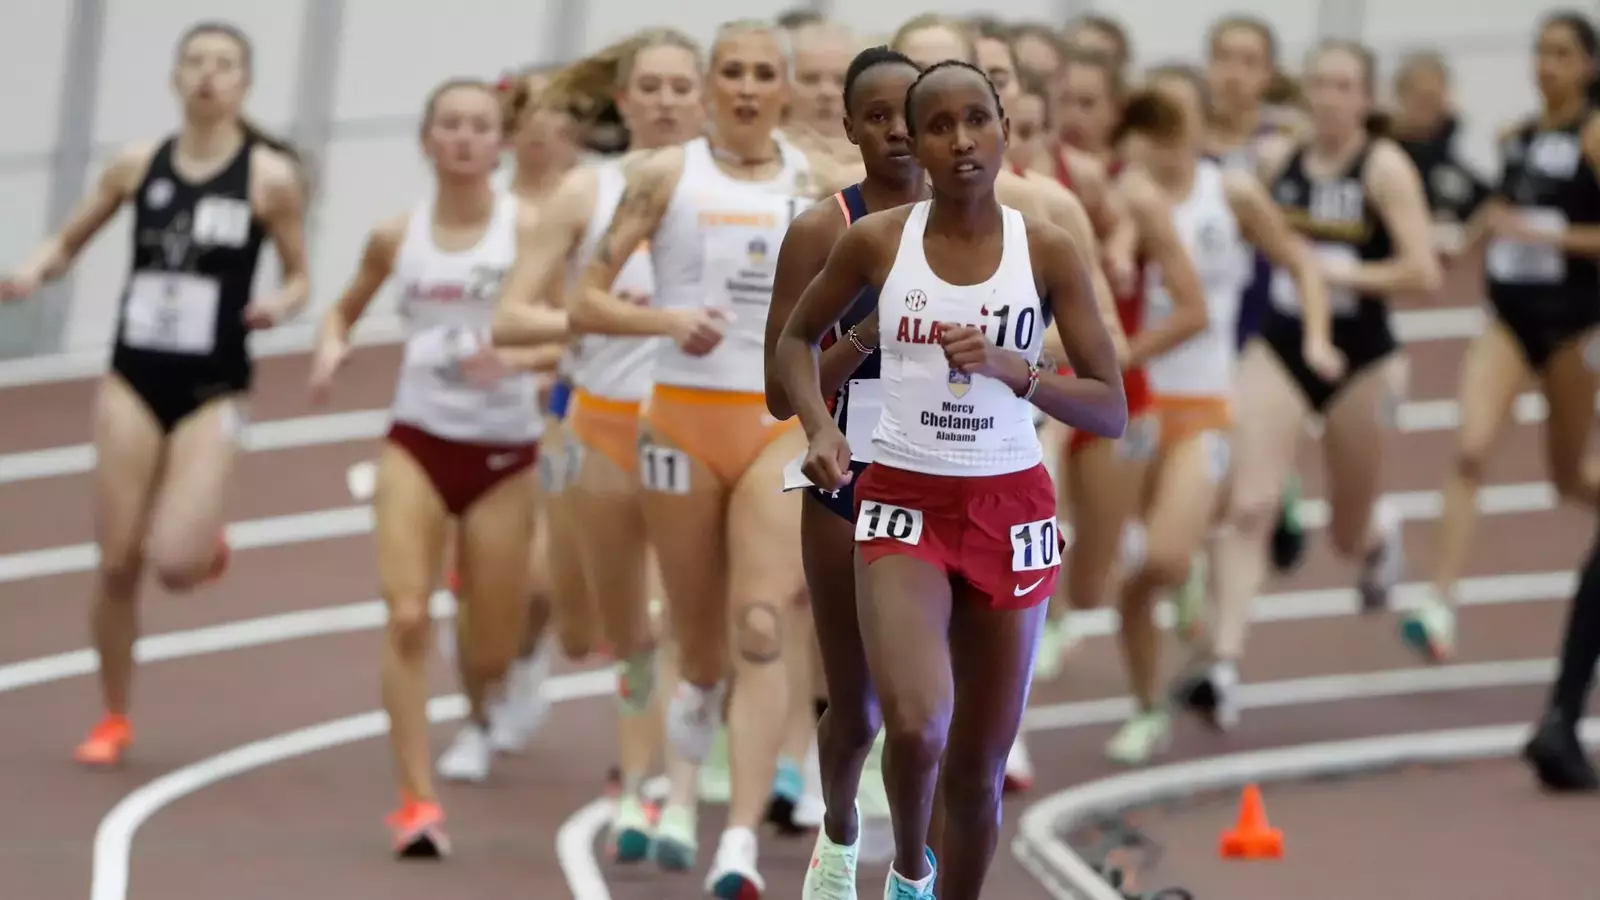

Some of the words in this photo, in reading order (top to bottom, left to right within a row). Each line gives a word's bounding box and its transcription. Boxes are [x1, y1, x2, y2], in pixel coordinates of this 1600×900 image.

[993, 304, 1035, 350] 10
[920, 411, 995, 431] Chelangat
[942, 401, 974, 414] Mercy
[936, 430, 976, 443] Alabama
[646, 451, 677, 489] 11
[864, 504, 914, 540] 10
[1015, 521, 1054, 567] 10
